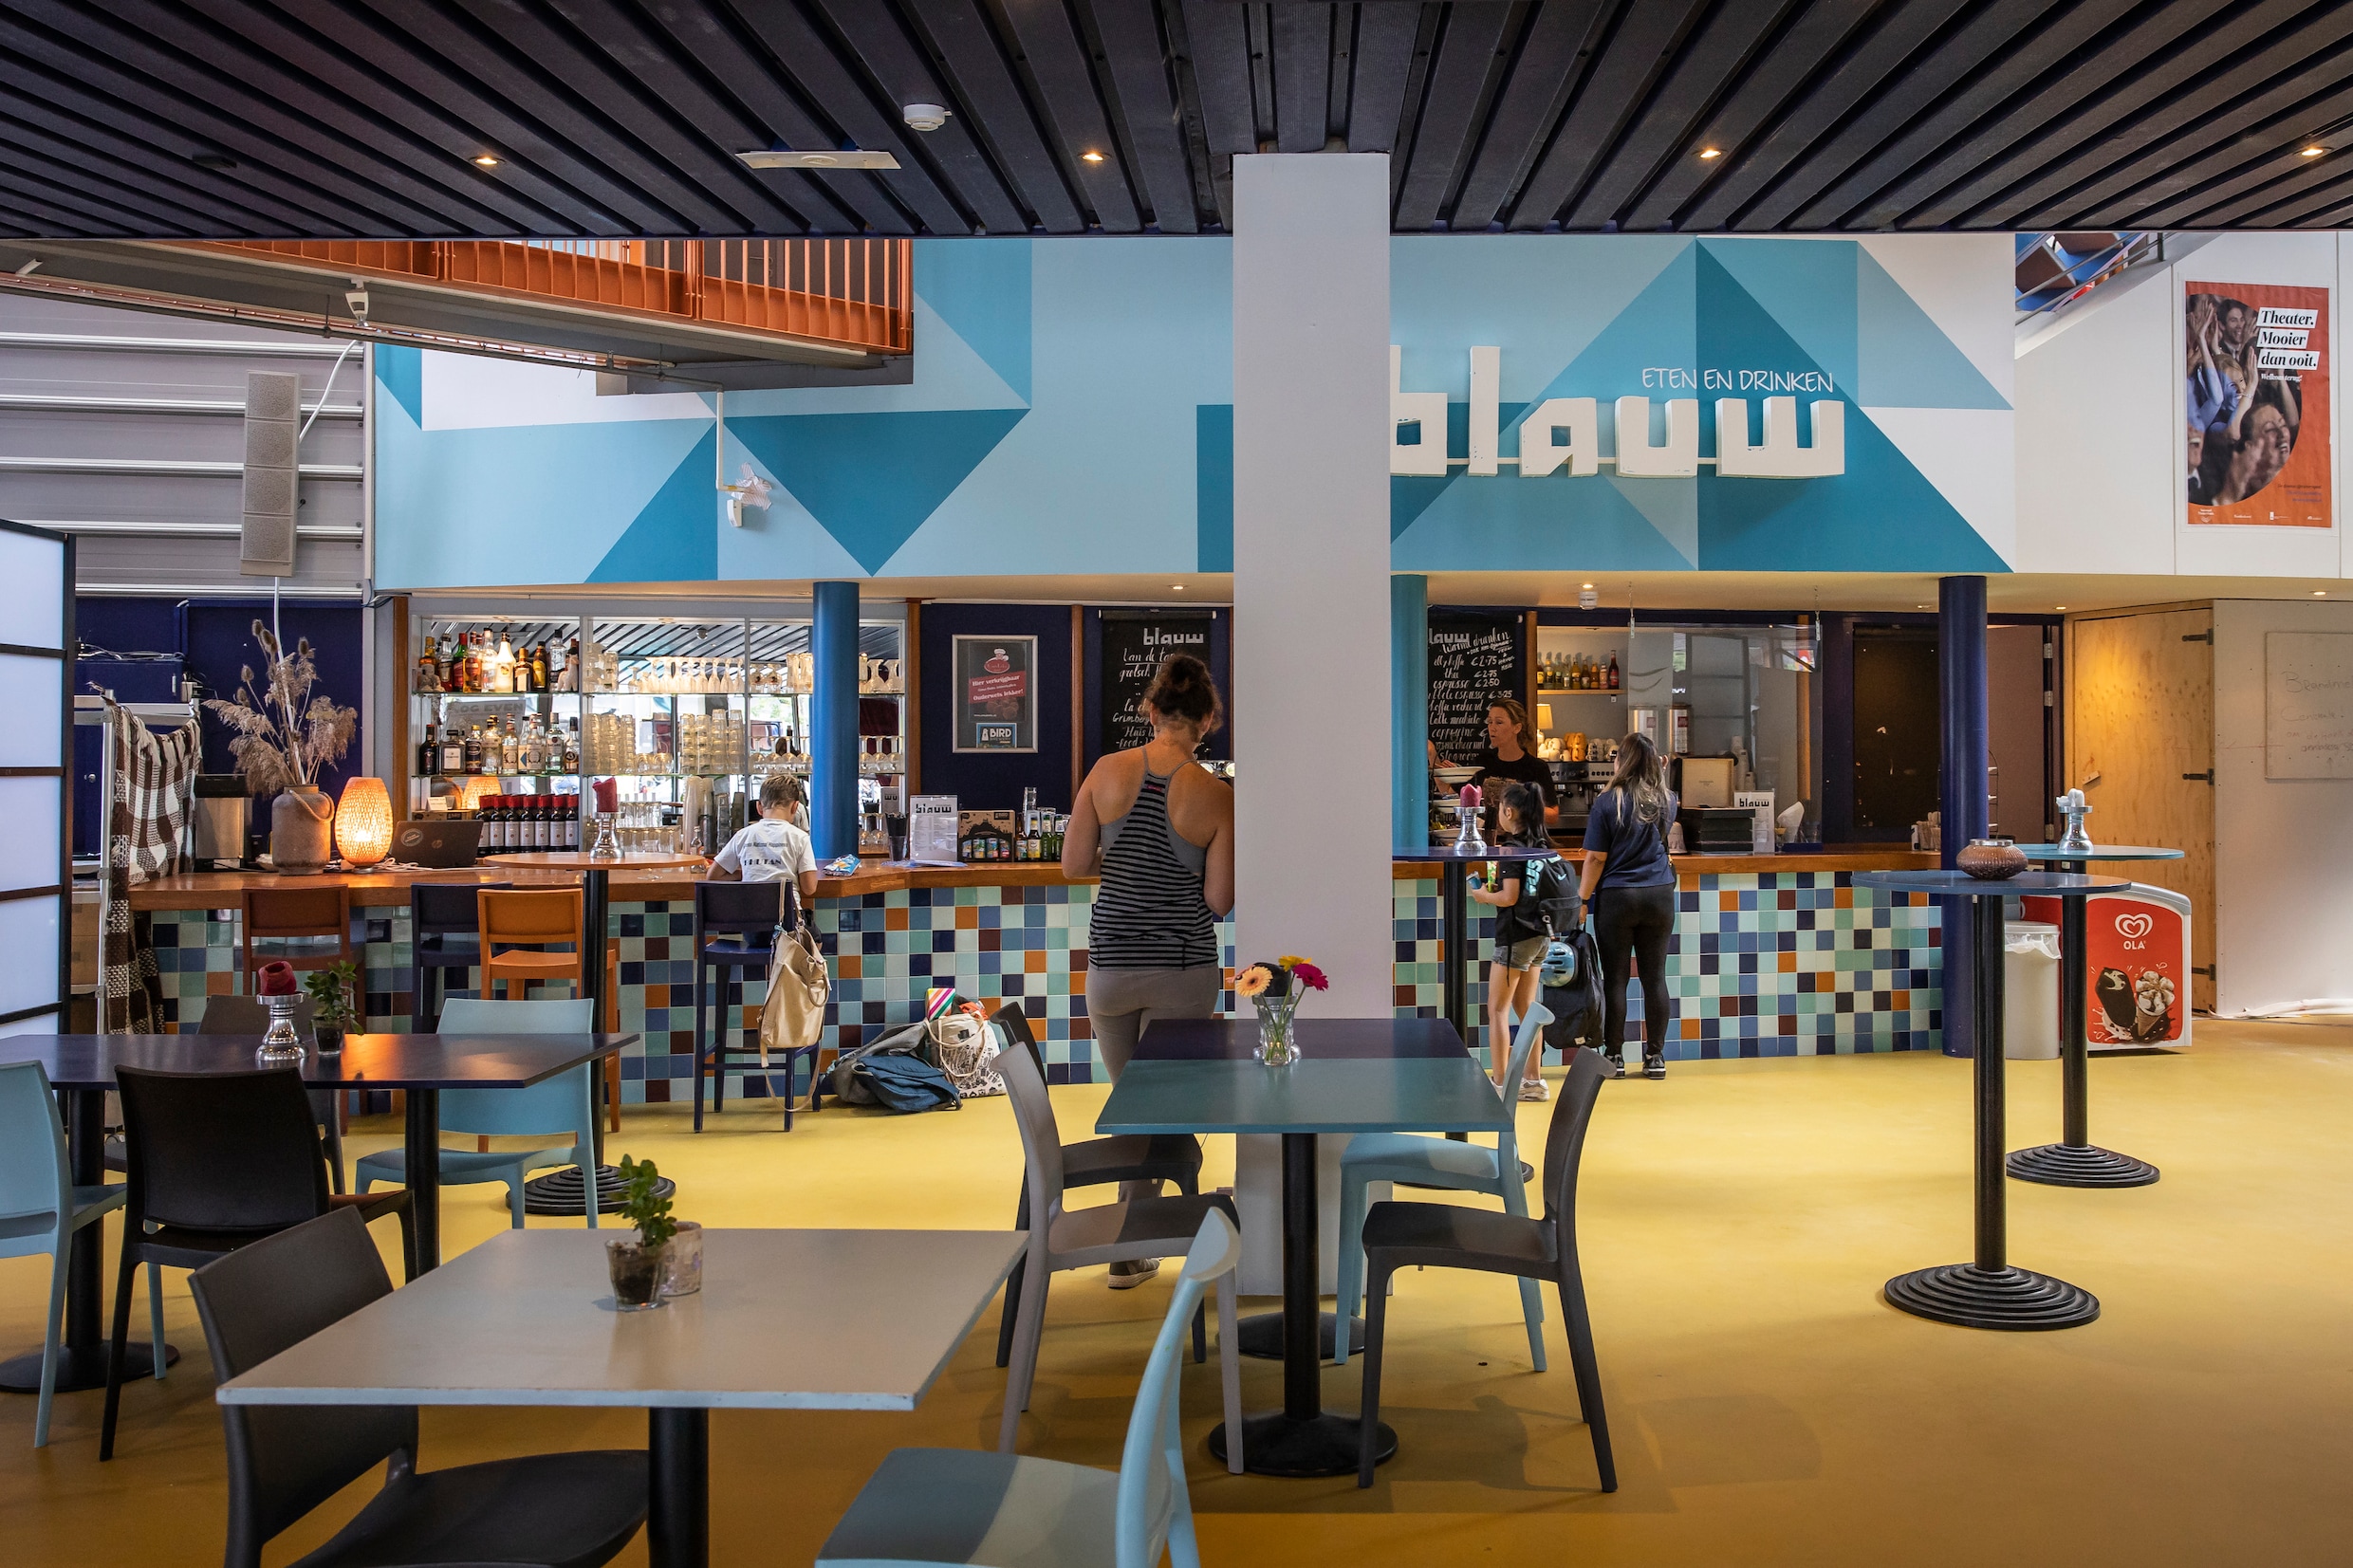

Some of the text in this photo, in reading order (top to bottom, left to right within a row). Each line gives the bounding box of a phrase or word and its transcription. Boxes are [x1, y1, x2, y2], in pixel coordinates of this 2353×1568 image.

[2261, 310, 2314, 325] Theater.
[2260, 331, 2307, 345] Mooier
[2261, 352, 2317, 367] dan ooit.
[1641, 367, 1834, 393] ETEN EN DRINKEN
[1390, 345, 1844, 478] blauw
[1143, 627, 1204, 645] blauw
[1429, 628, 1470, 644] lauw
[484, 703, 524, 711] EVEN
[990, 729, 1011, 737] BIRD
[916, 803, 952, 814] blauw
[1739, 798, 1769, 807] blauw
[2123, 940, 2146, 950] OLA
